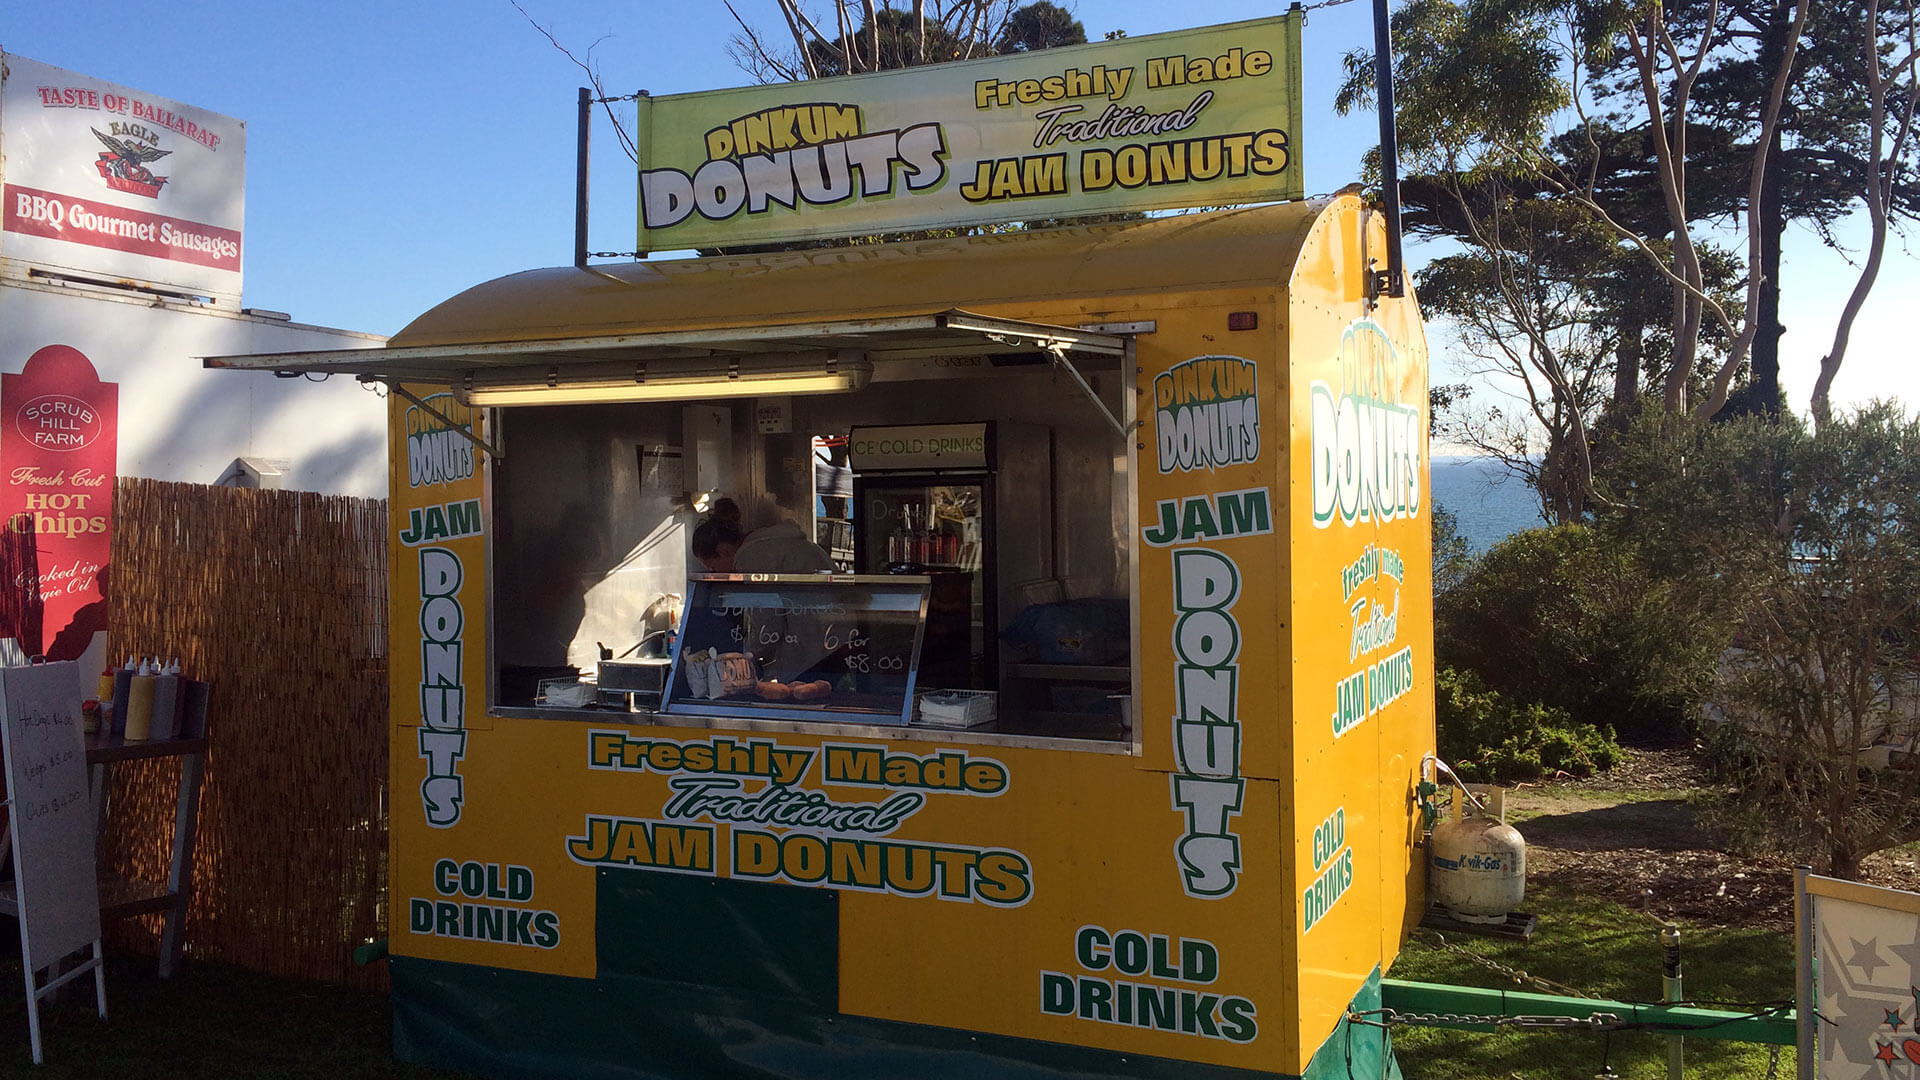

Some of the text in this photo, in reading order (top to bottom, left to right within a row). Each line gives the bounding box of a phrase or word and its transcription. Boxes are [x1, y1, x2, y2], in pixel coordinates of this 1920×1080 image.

[975, 47, 1273, 110] Freshly Made
[38, 87, 220, 151] TASTE OF BALLARAT
[109, 121, 159, 147] EAGLE
[706, 103, 861, 161] DINKUM
[1033, 91, 1213, 149] Traditional
[641, 123, 947, 229] DONUTS
[959, 130, 1290, 203] JAM DONUTS
[16, 193, 238, 259] BBQ Gourmet Sausages
[1153, 355, 1257, 408] DINKUM
[26, 402, 94, 425] SCRUB
[35, 432, 84, 445] FARM
[41, 417, 81, 430] HILL
[1156, 397, 1260, 475] DONUTS
[408, 427, 475, 487] DONUTS
[880, 439, 923, 455] COLD
[929, 437, 983, 453] DRINKS
[1310, 380, 1420, 529] DONUTS
[10, 466, 106, 487] Fresh Cut
[25, 493, 92, 510] HOT
[8, 511, 107, 539] Chips
[400, 499, 484, 546] JAM
[1142, 487, 1274, 547] JAM
[15, 560, 99, 589] Cooked in
[67, 576, 93, 594] Oil
[1342, 542, 1404, 603] freshly made
[848, 629, 870, 649] for
[1349, 588, 1399, 664] Traditional
[418, 547, 468, 829] DONUTS
[1332, 645, 1412, 739] JAM DONUTS
[1169, 547, 1246, 900] DONUTS
[588, 729, 1010, 798] Freshly Made
[664, 777, 926, 837] Traditional
[565, 814, 1035, 909] JAM DONUTS
[1313, 806, 1345, 872] COLD
[434, 859, 534, 902] COLD
[1303, 846, 1352, 936] DRINKS
[409, 898, 561, 950] DRINKS
[1075, 924, 1219, 985] COLD
[1040, 970, 1258, 1044] DRINKS
